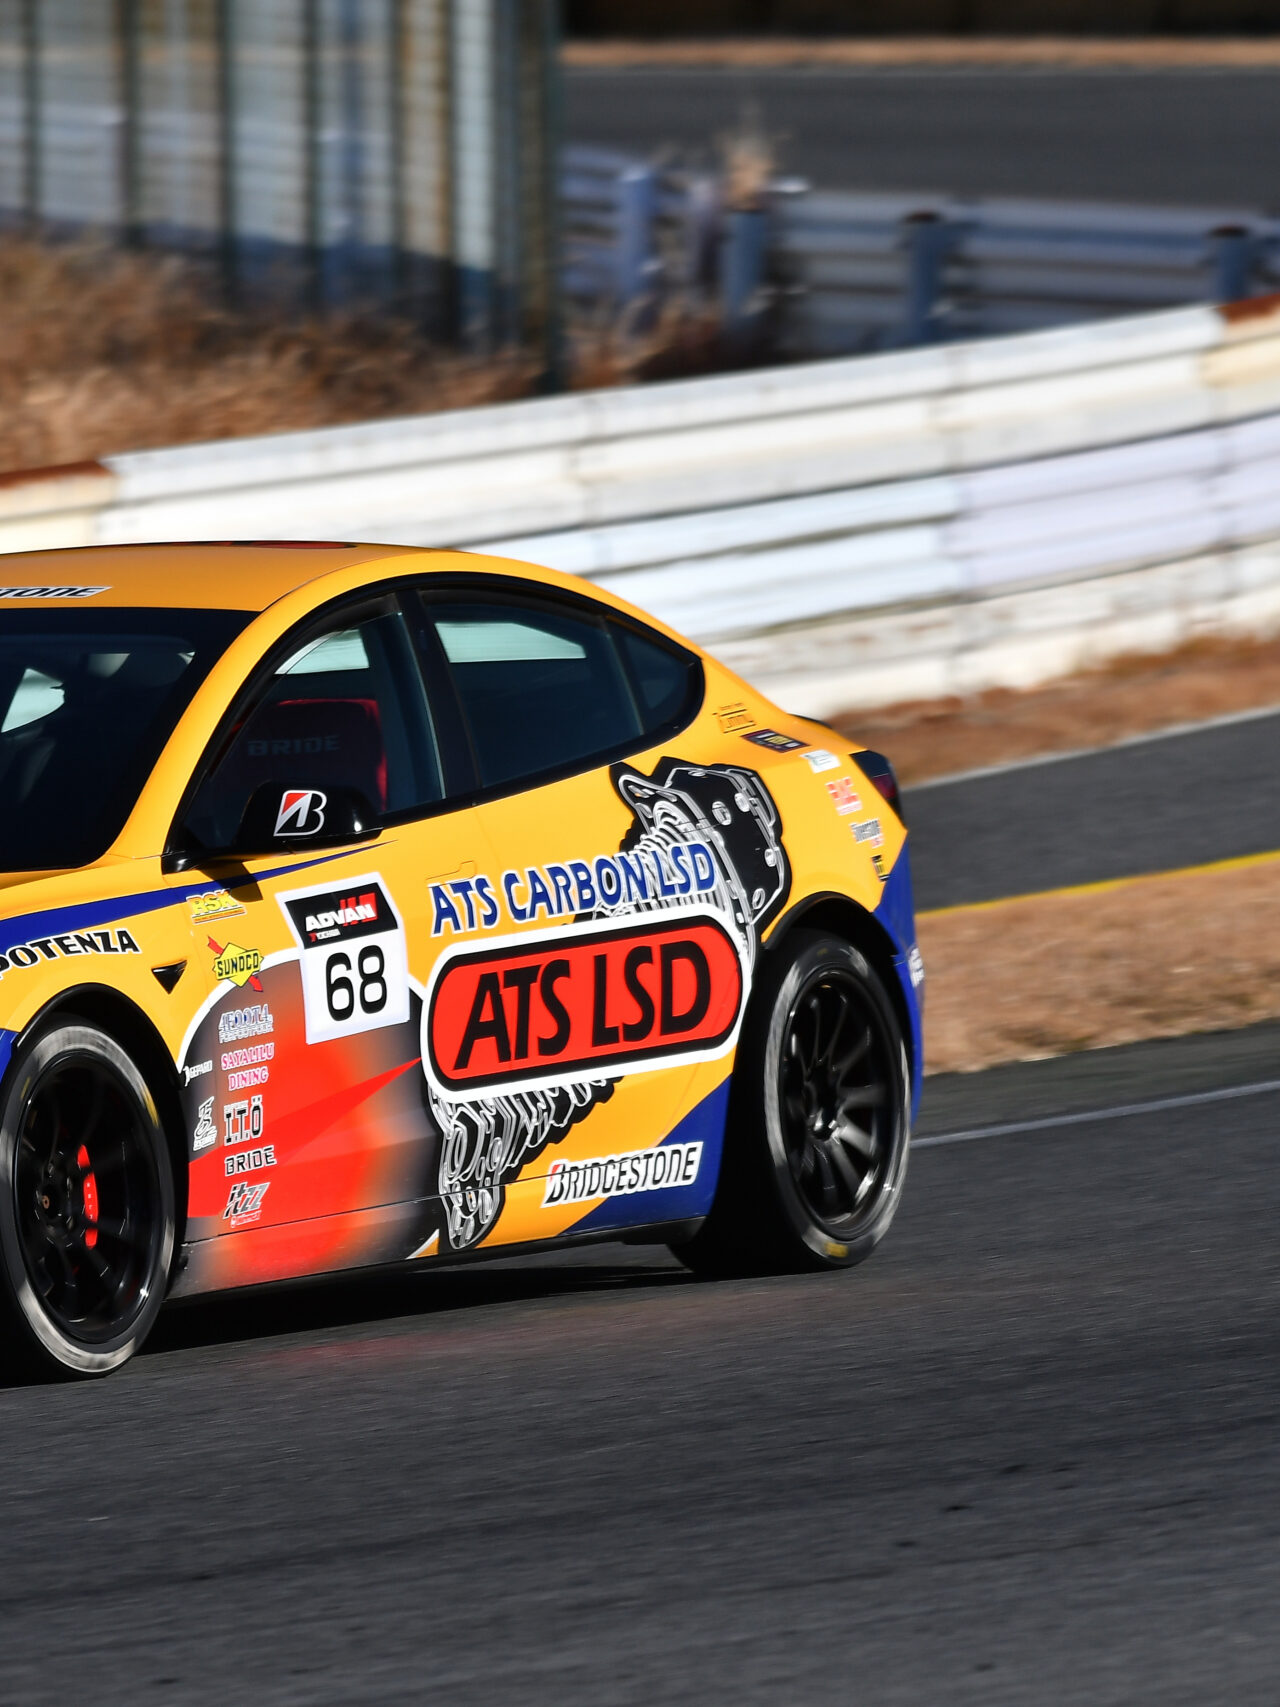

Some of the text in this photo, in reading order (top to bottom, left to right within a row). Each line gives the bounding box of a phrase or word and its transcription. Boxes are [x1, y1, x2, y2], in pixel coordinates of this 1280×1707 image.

[247, 735, 342, 756] BRIDE
[431, 843, 716, 935] ATS CARBON LSD
[305, 903, 377, 932] ADVAN
[217, 952, 259, 977] SUNOCO
[325, 945, 388, 1022] 68
[453, 940, 712, 1071] ATS LSD
[228, 1067, 269, 1091] DINING
[225, 1146, 276, 1175] BRIDE
[544, 1146, 698, 1205] BRIDGESTONE
